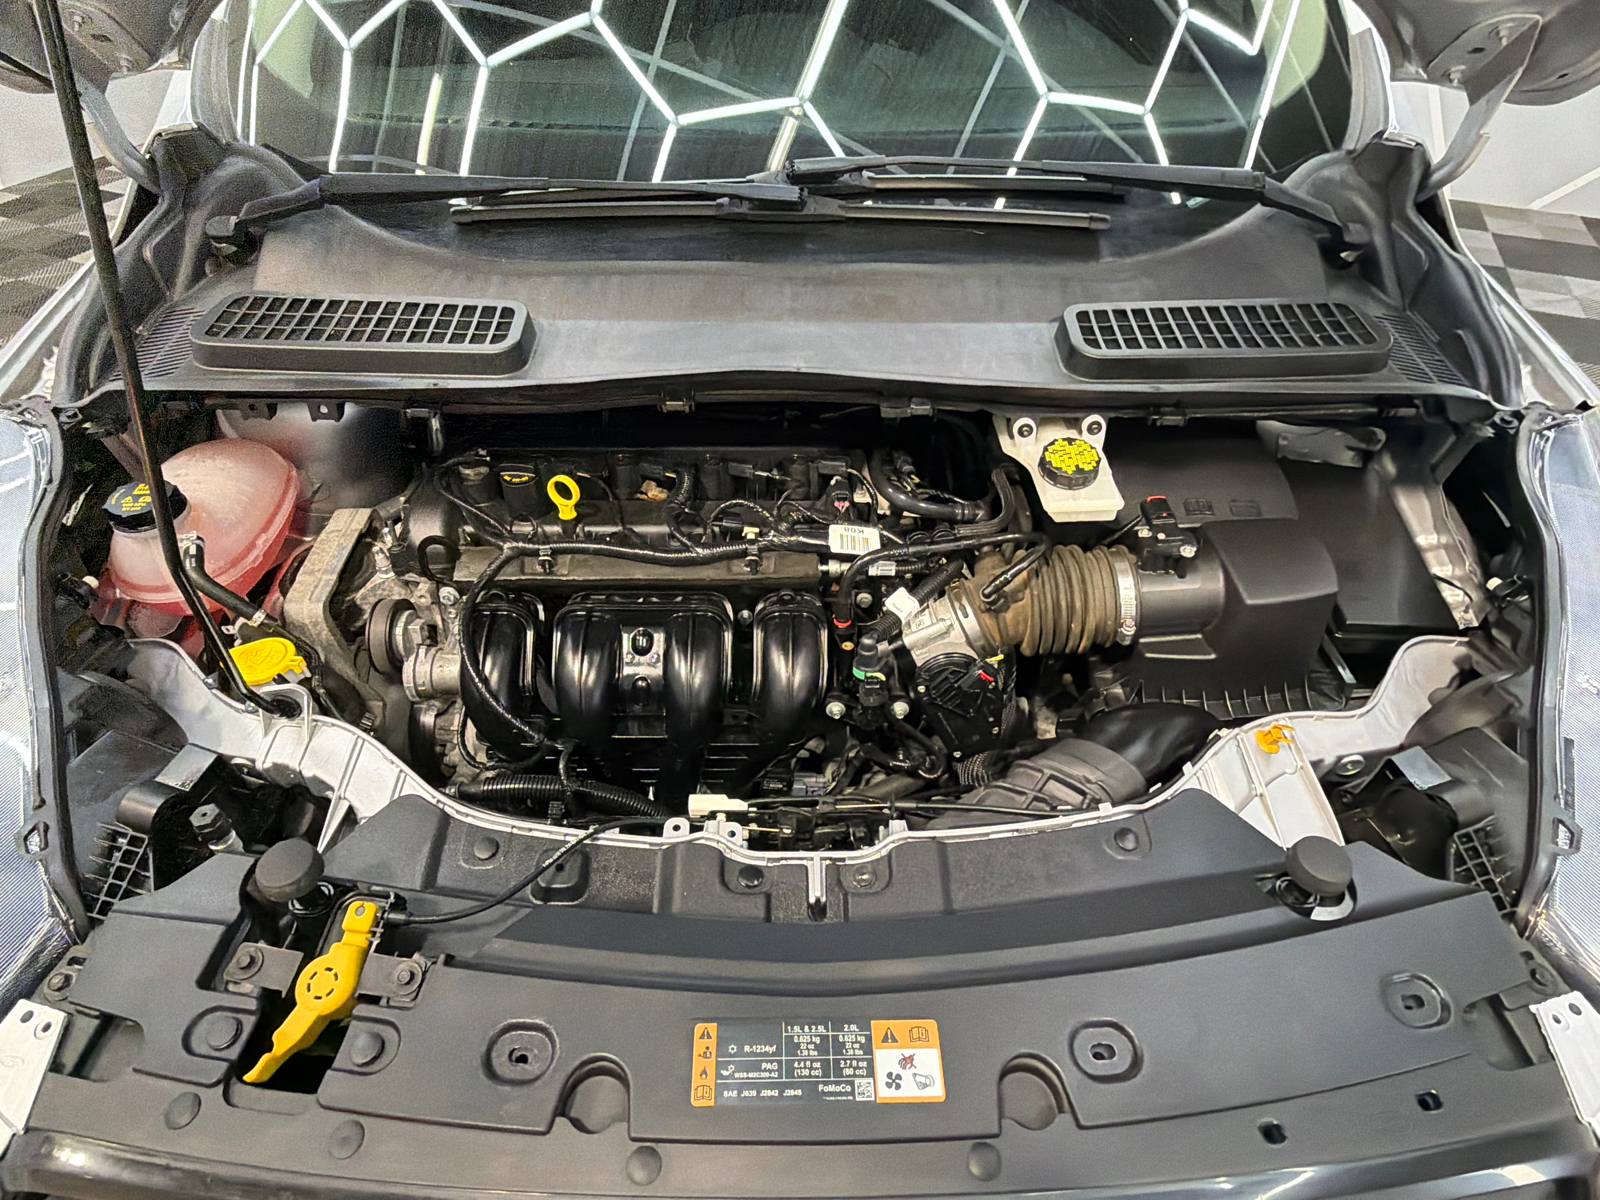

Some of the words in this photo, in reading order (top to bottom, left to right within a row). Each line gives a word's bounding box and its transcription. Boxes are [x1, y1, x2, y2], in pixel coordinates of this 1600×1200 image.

[843, 526, 864, 534] K08
[787, 1025, 802, 1033] 1.5L
[812, 1035, 820, 1044] kg
[857, 1034, 866, 1043] kg
[744, 1044, 777, 1054] R-1234yf
[794, 1069, 810, 1077] (130
[811, 1069, 822, 1077] cc)
[842, 1068, 854, 1076] (80
[855, 1068, 867, 1076] cc)
[818, 1084, 851, 1092] FoMoCo
